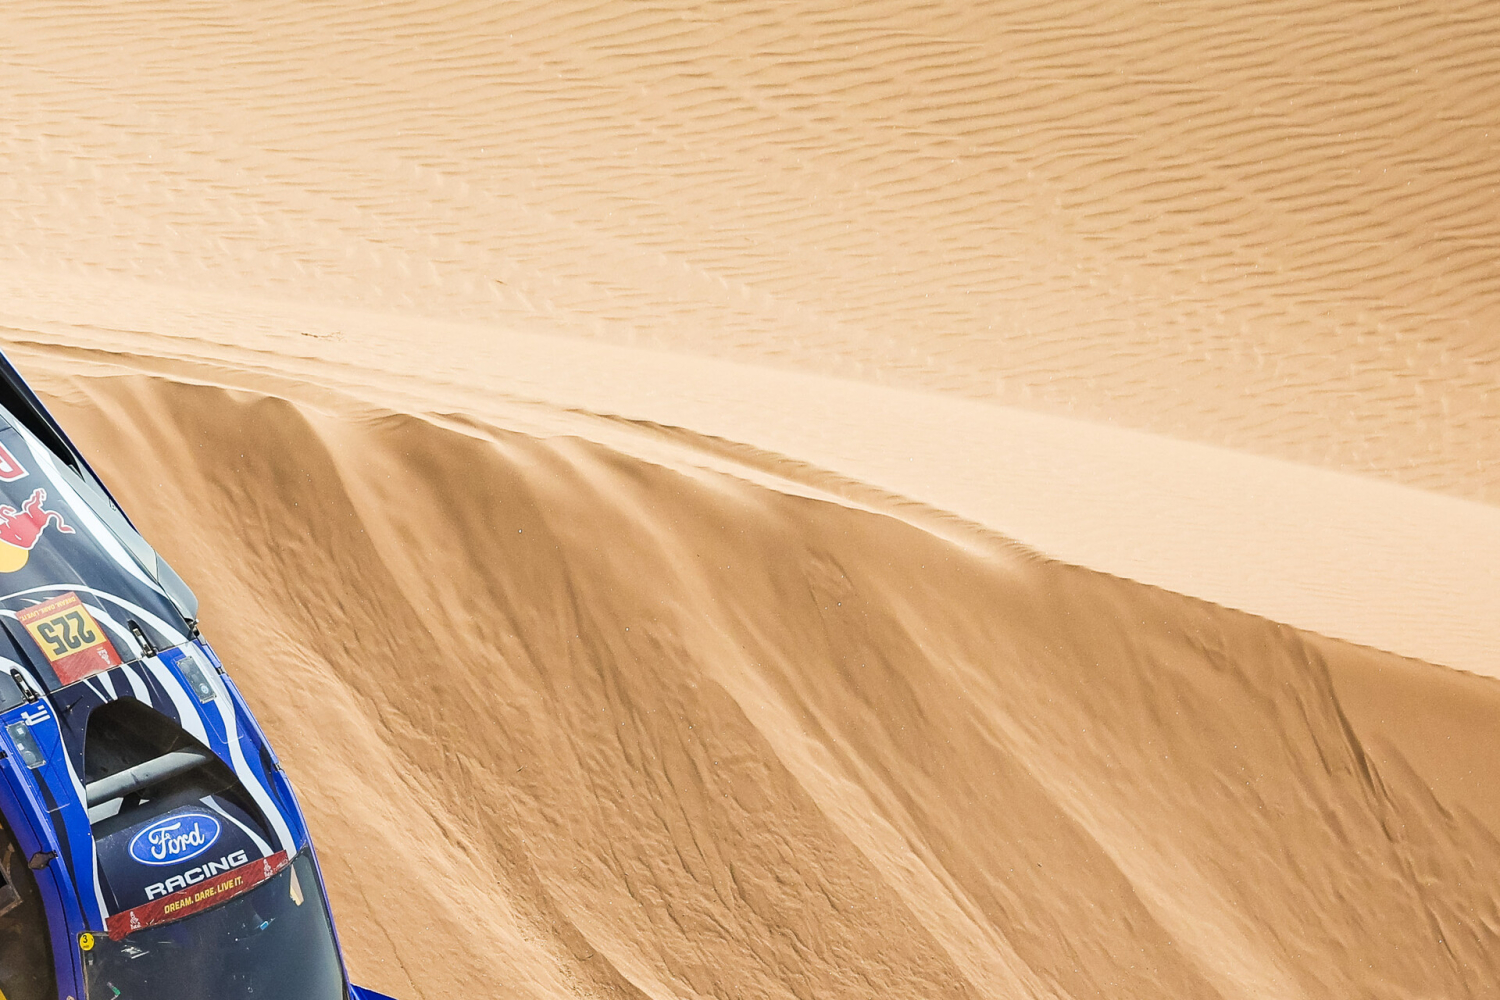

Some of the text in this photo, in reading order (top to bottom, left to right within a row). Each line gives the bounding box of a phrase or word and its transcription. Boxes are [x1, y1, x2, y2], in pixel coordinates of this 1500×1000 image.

[36, 610, 96, 655] 225
[148, 822, 205, 859] Ford
[144, 850, 248, 900] RACING
[164, 896, 194, 914] DREAM.
[194, 887, 217, 902] DARE.
[82, 934, 89, 943] 3
